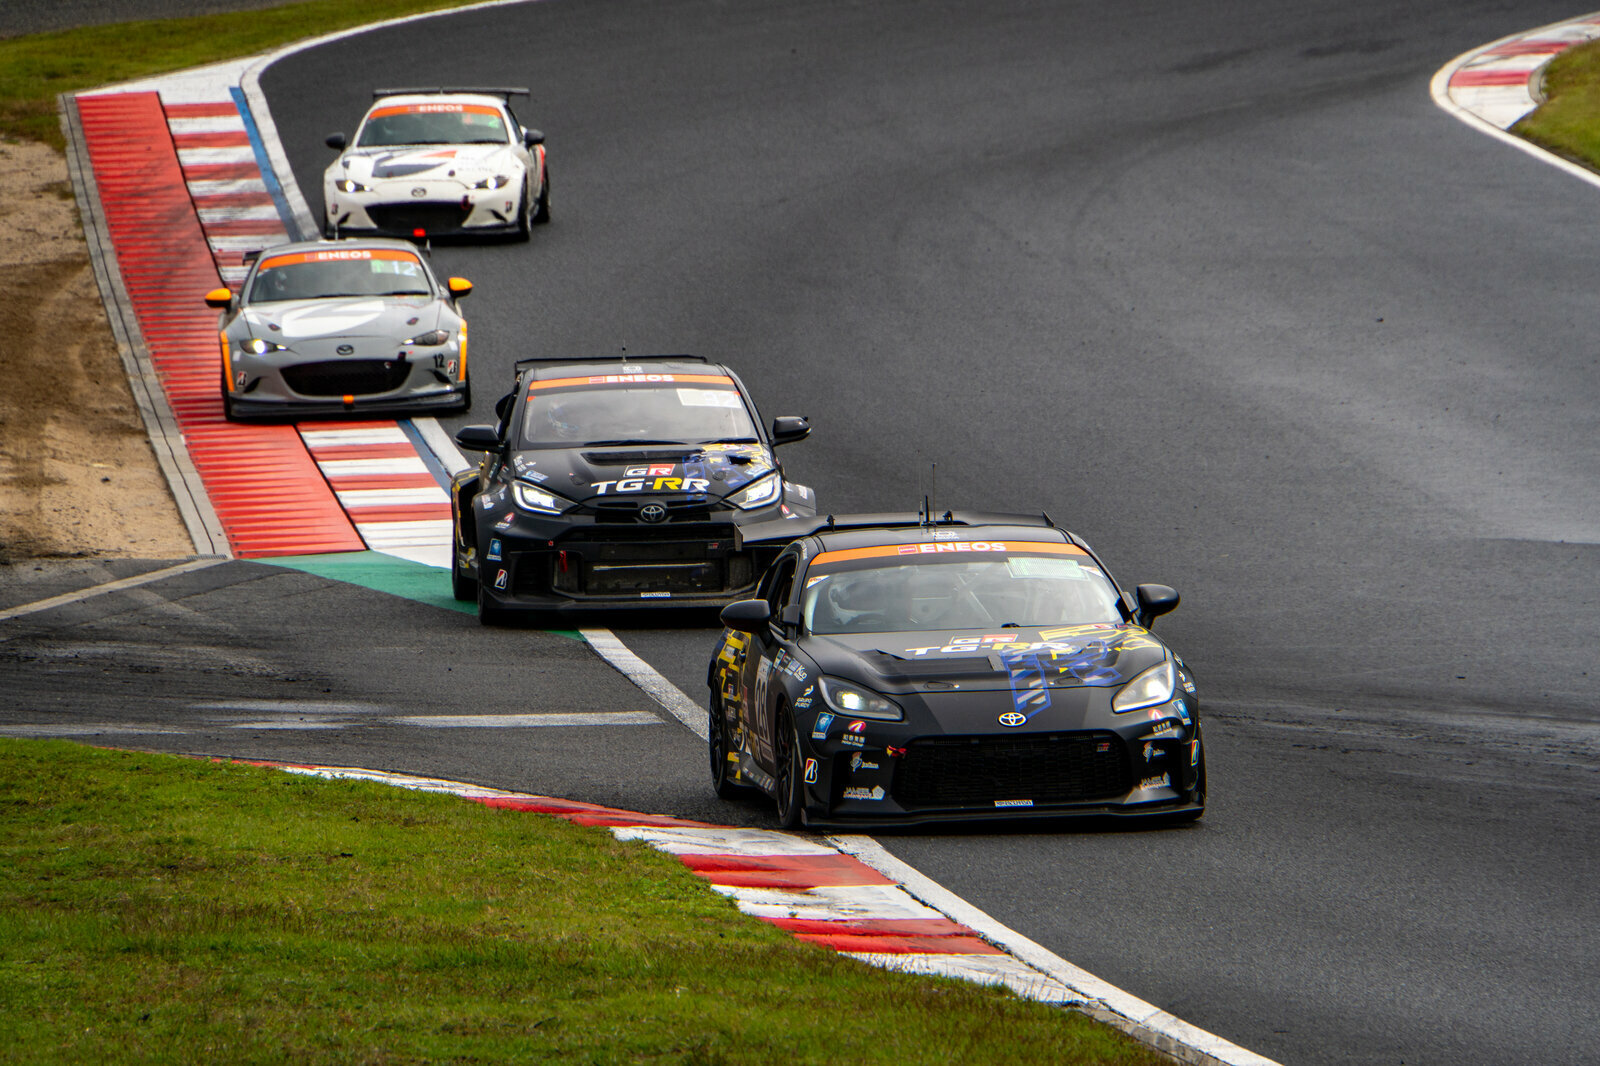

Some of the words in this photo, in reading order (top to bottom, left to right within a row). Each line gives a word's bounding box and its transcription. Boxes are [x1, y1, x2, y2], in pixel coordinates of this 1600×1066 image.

[418, 104, 464, 112] ENEOS
[318, 251, 372, 260] ENEOS
[391, 260, 417, 277] 12
[433, 354, 445, 369] 12
[606, 375, 674, 383] ENEOS
[626, 467, 673, 476] GR
[590, 477, 710, 495] TG-RR
[919, 541, 1007, 553] ENEOS
